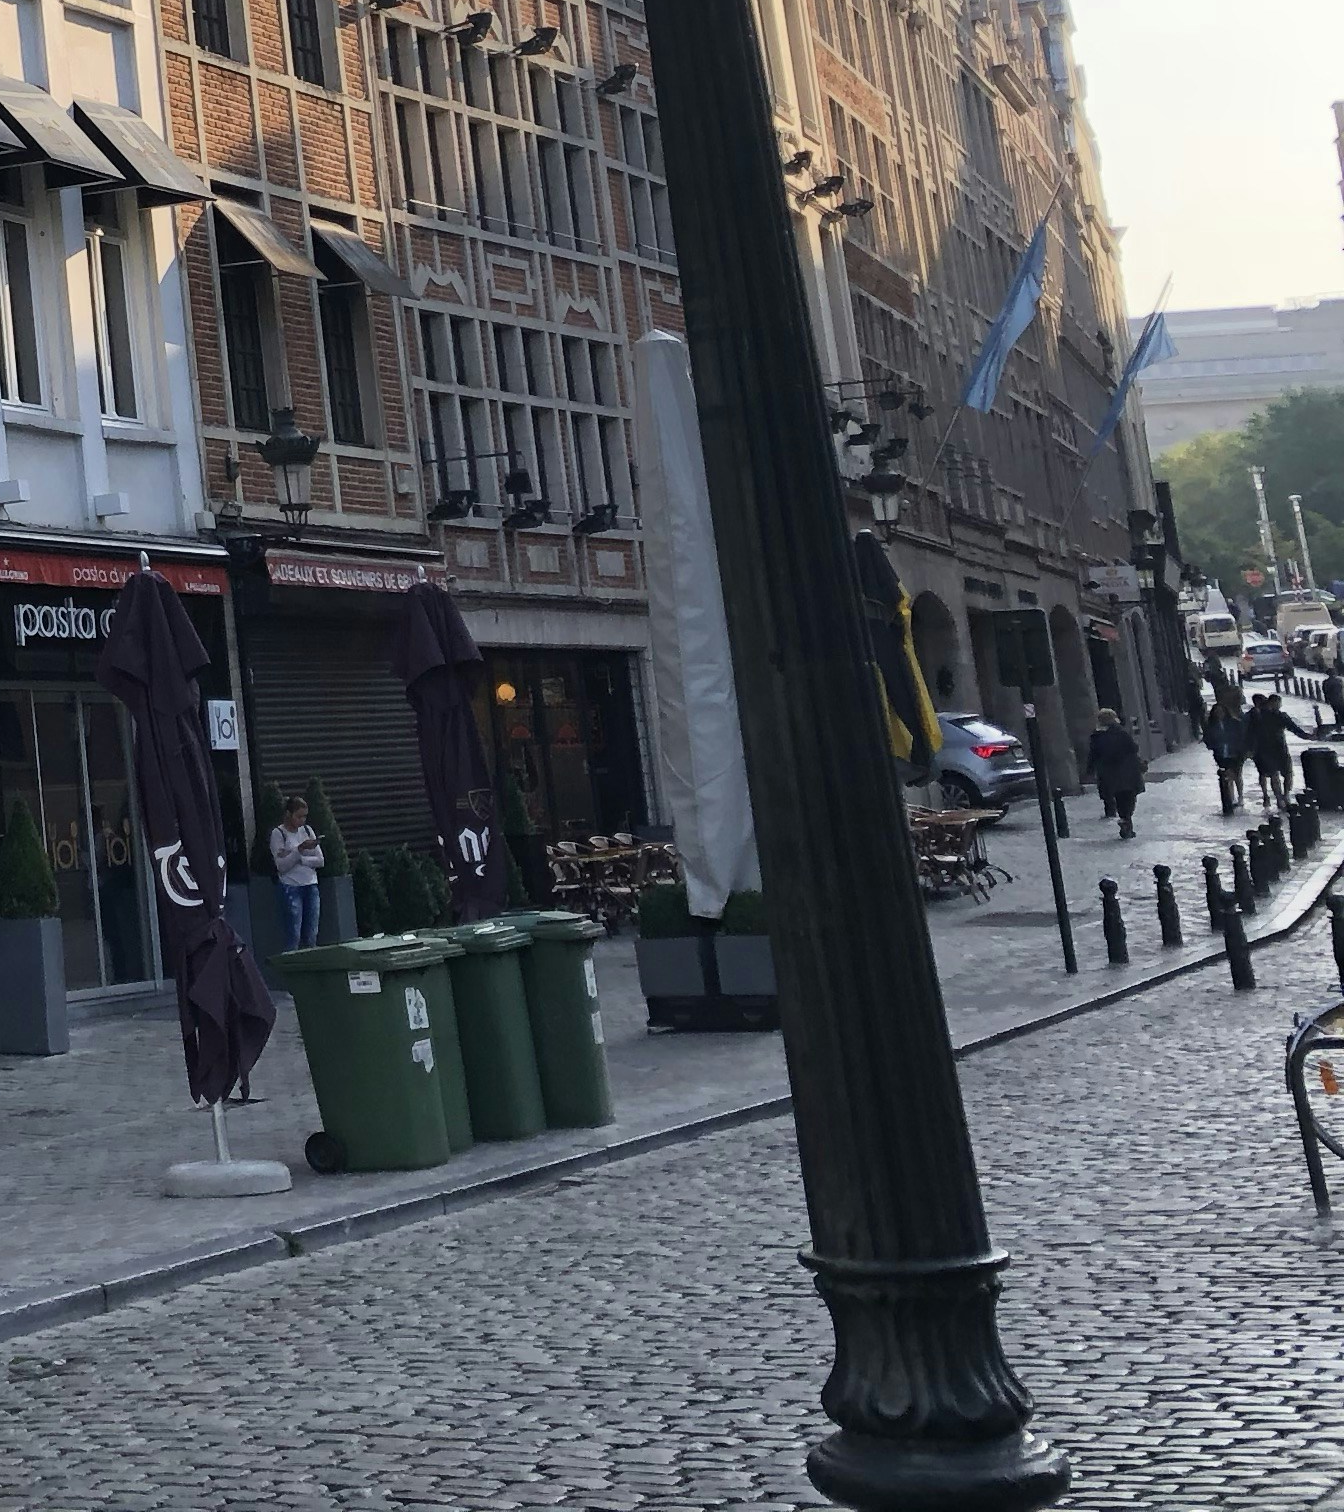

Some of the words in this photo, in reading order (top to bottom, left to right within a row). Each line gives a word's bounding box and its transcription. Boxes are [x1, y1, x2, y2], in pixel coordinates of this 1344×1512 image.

[73, 566, 108, 583] pasta
[268, 563, 315, 583] CADEAUX
[316, 567, 330, 584] ET
[331, 569, 384, 588] SOUVENIRS
[384, 573, 397, 589] DE
[14, 597, 97, 646] pasta
